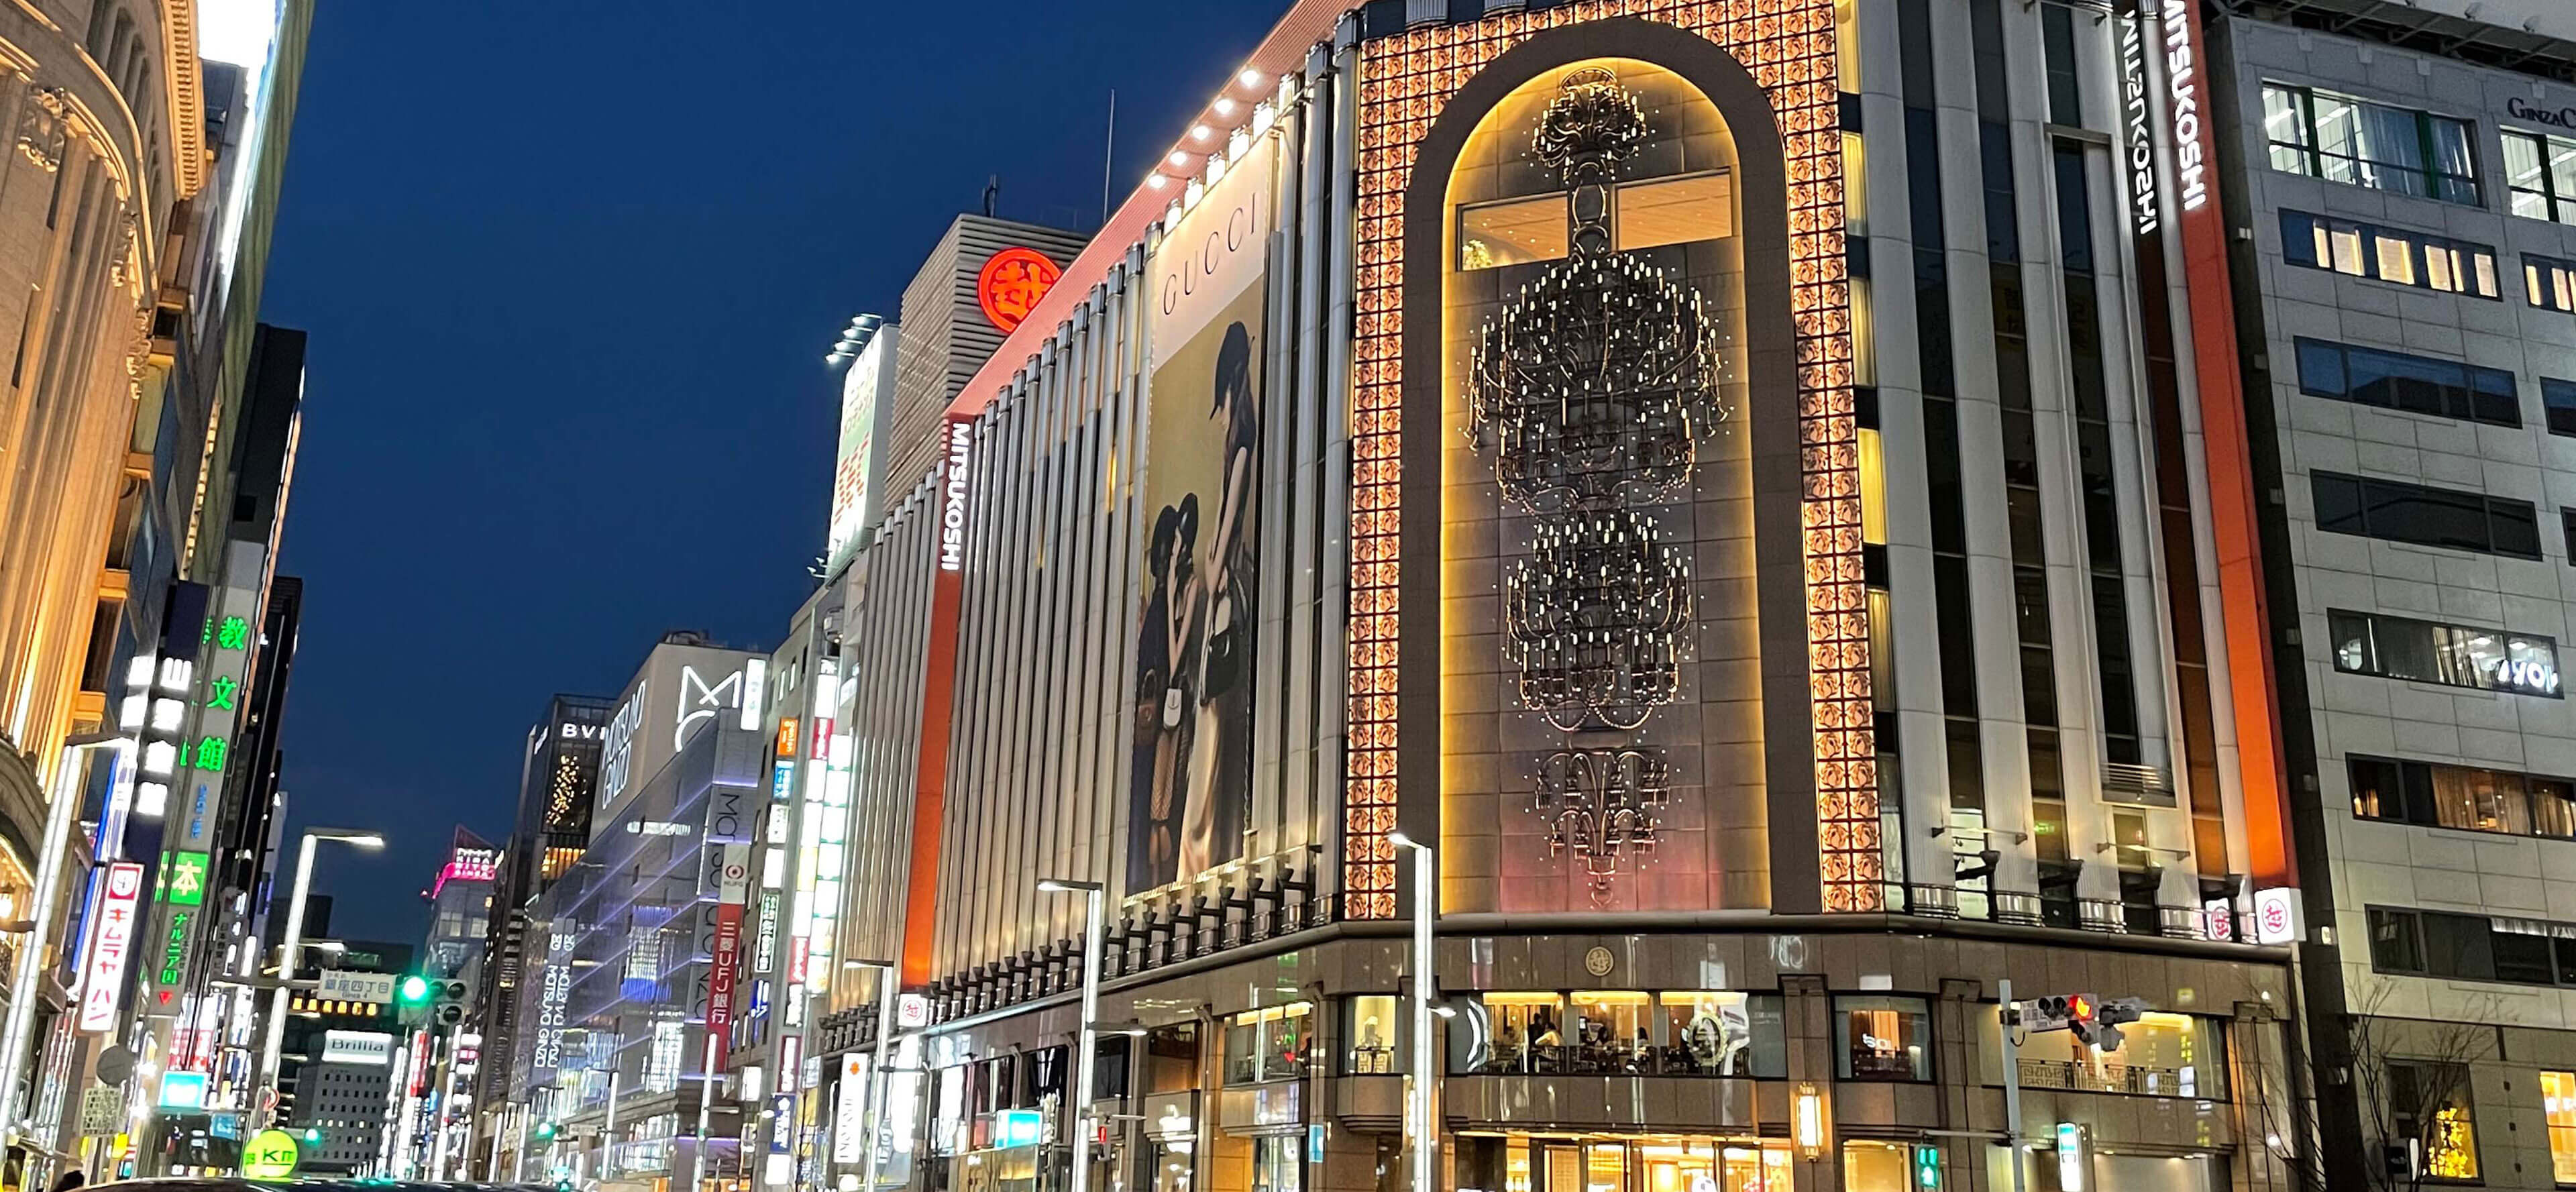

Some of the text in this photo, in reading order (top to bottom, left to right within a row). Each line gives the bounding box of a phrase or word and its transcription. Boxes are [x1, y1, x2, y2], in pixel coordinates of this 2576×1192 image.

[1163, 193, 1256, 315] GUCCI
[941, 421, 971, 571] MITSUKOSHI
[196, 616, 248, 771] 教文館
[171, 861, 201, 896] 本
[325, 979, 390, 993] 銀座四丁目
[711, 921, 737, 1025] 三菱UFJ銀行
[331, 1038, 384, 1052] Brillia
